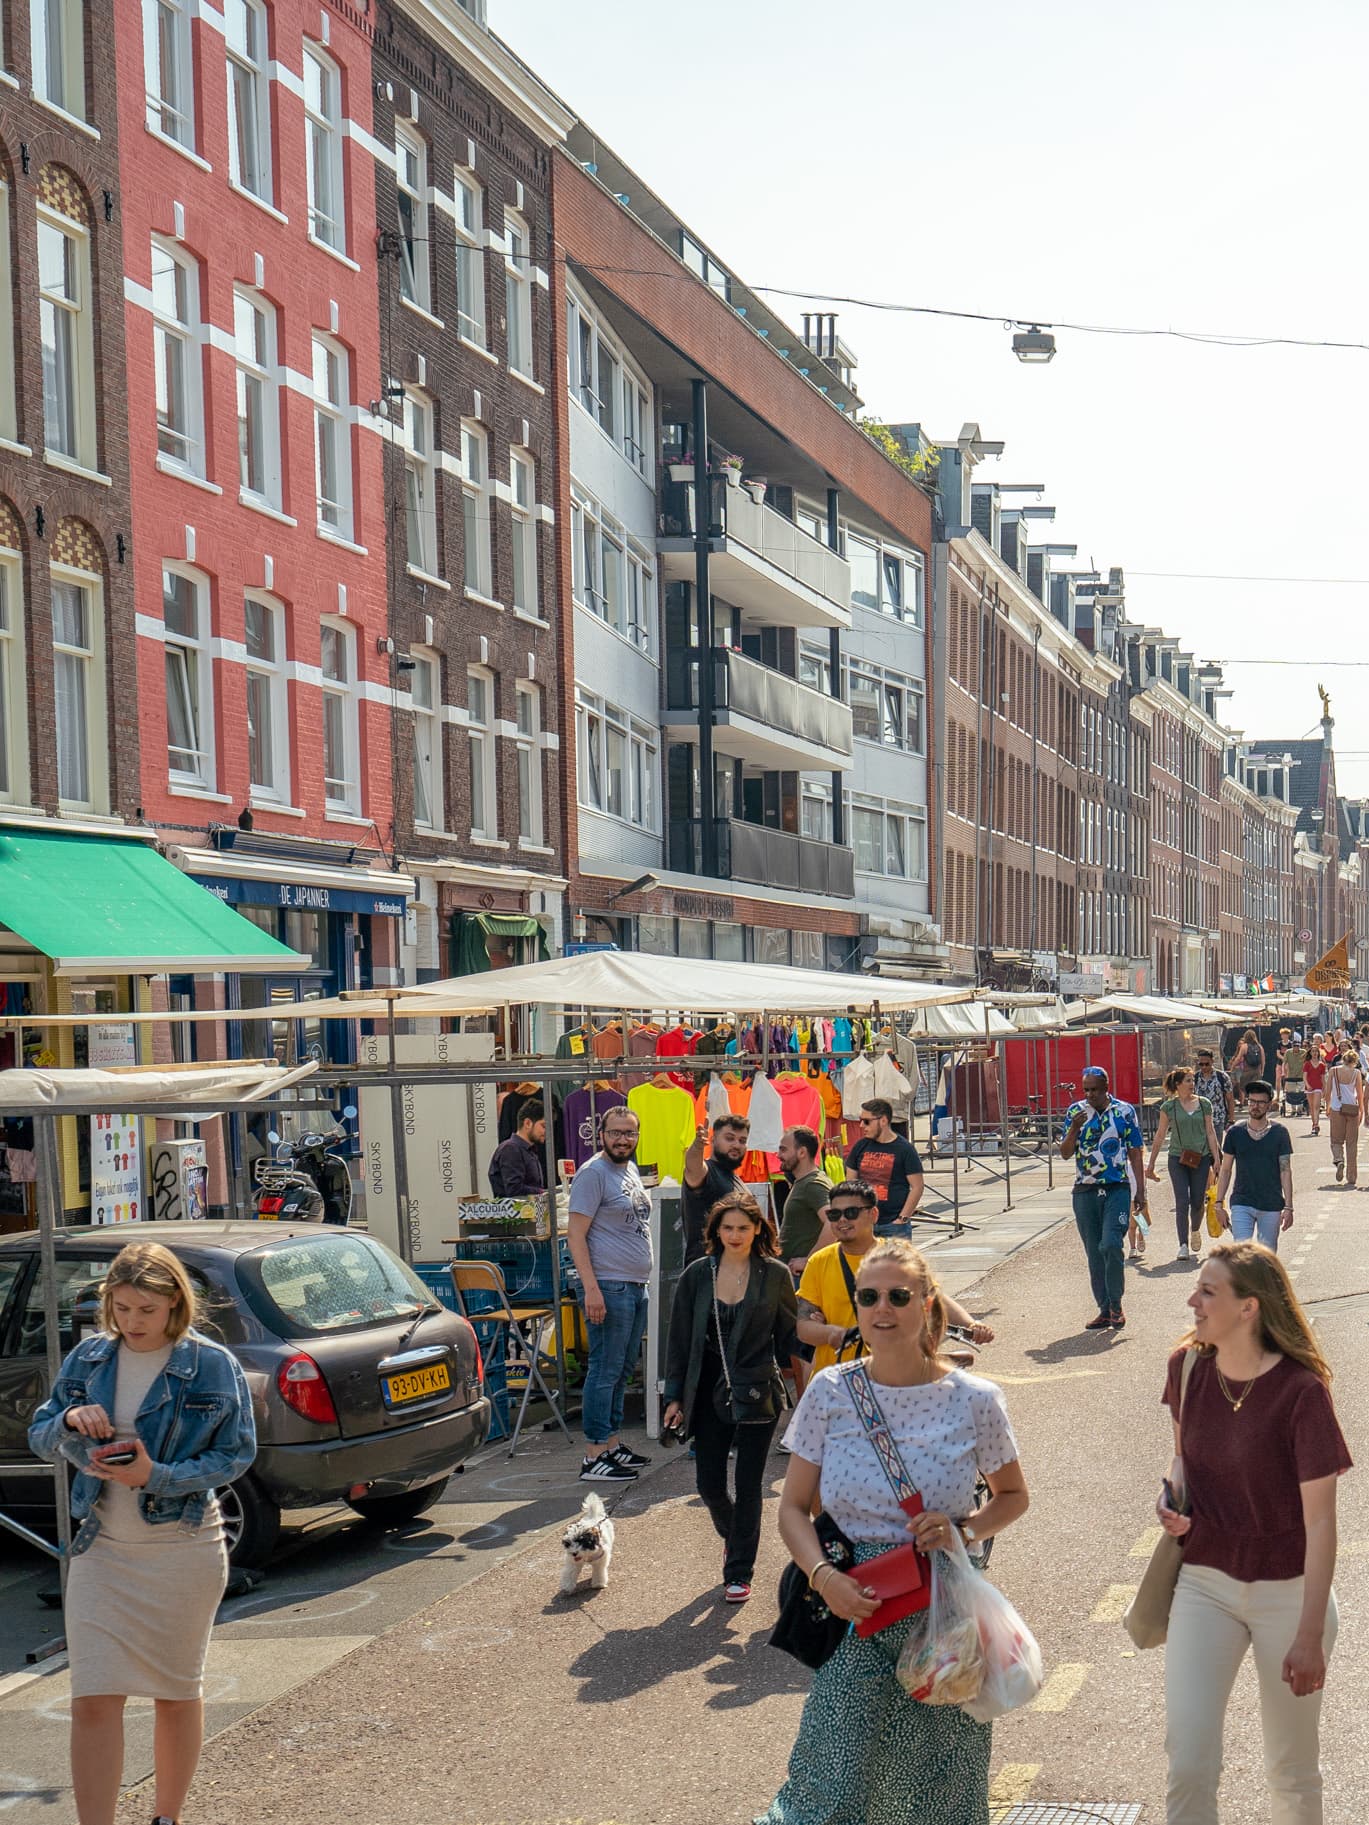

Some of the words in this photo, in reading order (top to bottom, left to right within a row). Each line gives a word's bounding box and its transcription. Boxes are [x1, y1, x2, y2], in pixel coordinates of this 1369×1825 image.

[281, 885, 292, 905] DE
[294, 887, 330, 908] JAPANNER
[403, 1084, 416, 1136] SKYBOND
[474, 1082, 486, 1134] SKYBOND
[371, 1141, 383, 1195] SKYBOND
[441, 1140, 453, 1193] SKYBOND
[409, 1199, 422, 1252] SKYBOND
[392, 1367, 447, 1398] 93-DV-KH
